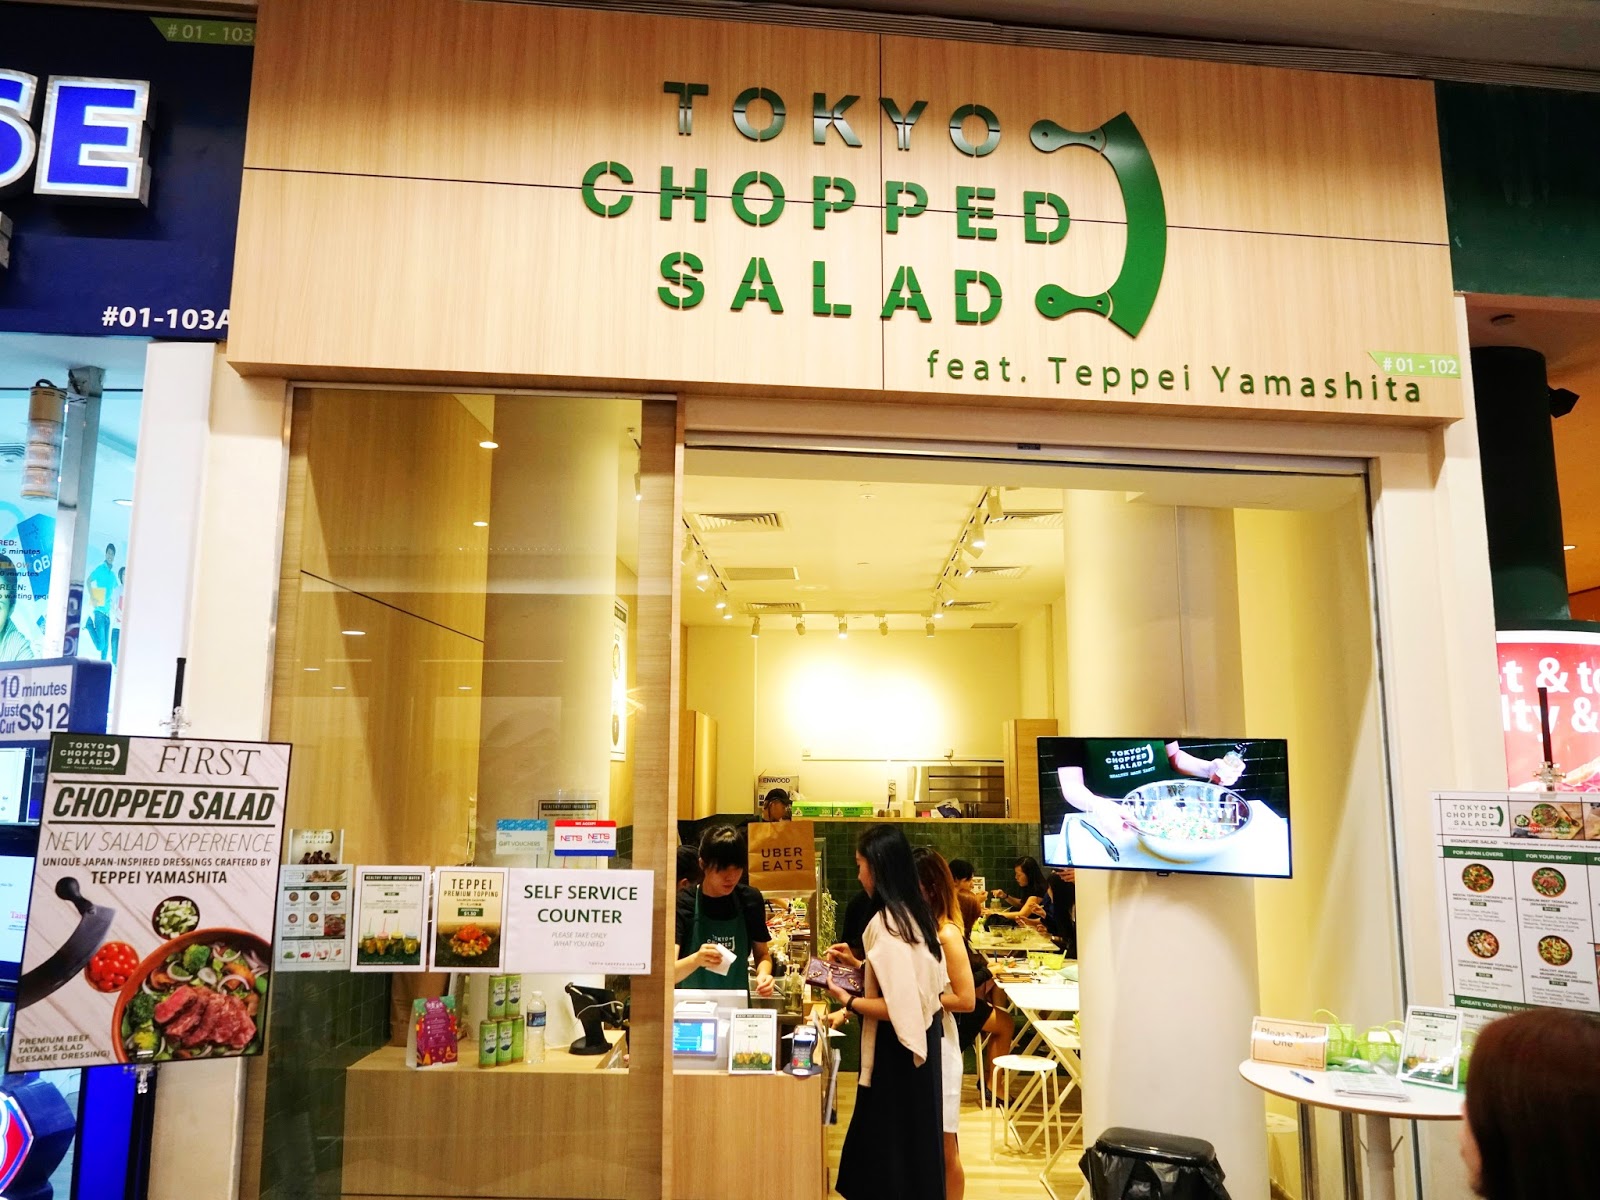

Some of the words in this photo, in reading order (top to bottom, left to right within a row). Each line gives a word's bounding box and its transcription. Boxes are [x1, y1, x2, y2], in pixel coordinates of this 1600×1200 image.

[182, 24, 203, 40] 01
[222, 26, 254, 43] 103
[663, 81, 1001, 158] TOKYO
[581, 160, 1071, 245] CHOPPED
[657, 251, 1003, 326] SALAD
[1396, 358, 1416, 373] 01
[1428, 359, 1458, 375] 102
[927, 349, 1027, 384] feat.
[1048, 356, 1192, 395] Teppei
[1211, 365, 1422, 403] Yamashita
[32, 554, 51, 574] QB
[1534, 656, 1571, 694] &
[0, 675, 21, 699] 10
[21, 681, 68, 698] minutes
[17, 700, 71, 735] S$12
[0, 719, 16, 735] Cut
[59, 749, 111, 758] CHOPPED
[1105, 752, 1148, 764] CHOPPED
[1110, 747, 1142, 757] TOKYO
[66, 757, 103, 766] SALAD
[68, 741, 105, 750] TOKYO
[156, 744, 262, 777] FIRST
[1113, 760, 1143, 771] SALAD
[52, 786, 184, 819] CHOPPED
[188, 791, 276, 821] SALAD
[1453, 804, 1487, 812] TOKYO
[45, 831, 96, 851] NEW
[98, 832, 160, 852] SALAD
[164, 833, 276, 853] EXPERIENCE
[560, 834, 583, 842] NETS
[587, 832, 611, 840] NETS
[761, 847, 803, 858] UBER
[42, 857, 81, 866] UNIQUE
[83, 857, 160, 867] JAPAN-INSPIRED
[162, 858, 213, 867] DRESSINGS
[214, 858, 258, 867] CRAFTERD
[260, 859, 271, 867] BY
[762, 860, 804, 872] EATS
[91, 871, 141, 884] TEPPEI
[146, 871, 228, 884] YAMASHITA
[451, 878, 493, 890] TEPPEI
[473, 890, 499, 898] TOPPING
[523, 885, 563, 899] SELF
[567, 885, 638, 901] SERVICE
[537, 908, 623, 924] COUNTER
[551, 931, 574, 939] PLEASE
[574, 931, 590, 939] TAKE
[590, 931, 608, 939] ONLY
[587, 940, 605, 948] NEED
[1481, 1001, 1499, 1009] YOUR
[19, 1036, 64, 1045] PREMIUM
[67, 1035, 90, 1043] BEEF
[18, 1046, 50, 1054] TATAKI
[52, 1043, 84, 1052] SALAD
[16, 1054, 58, 1063] (SESAME
[61, 1051, 110, 1060] DRESSING)
